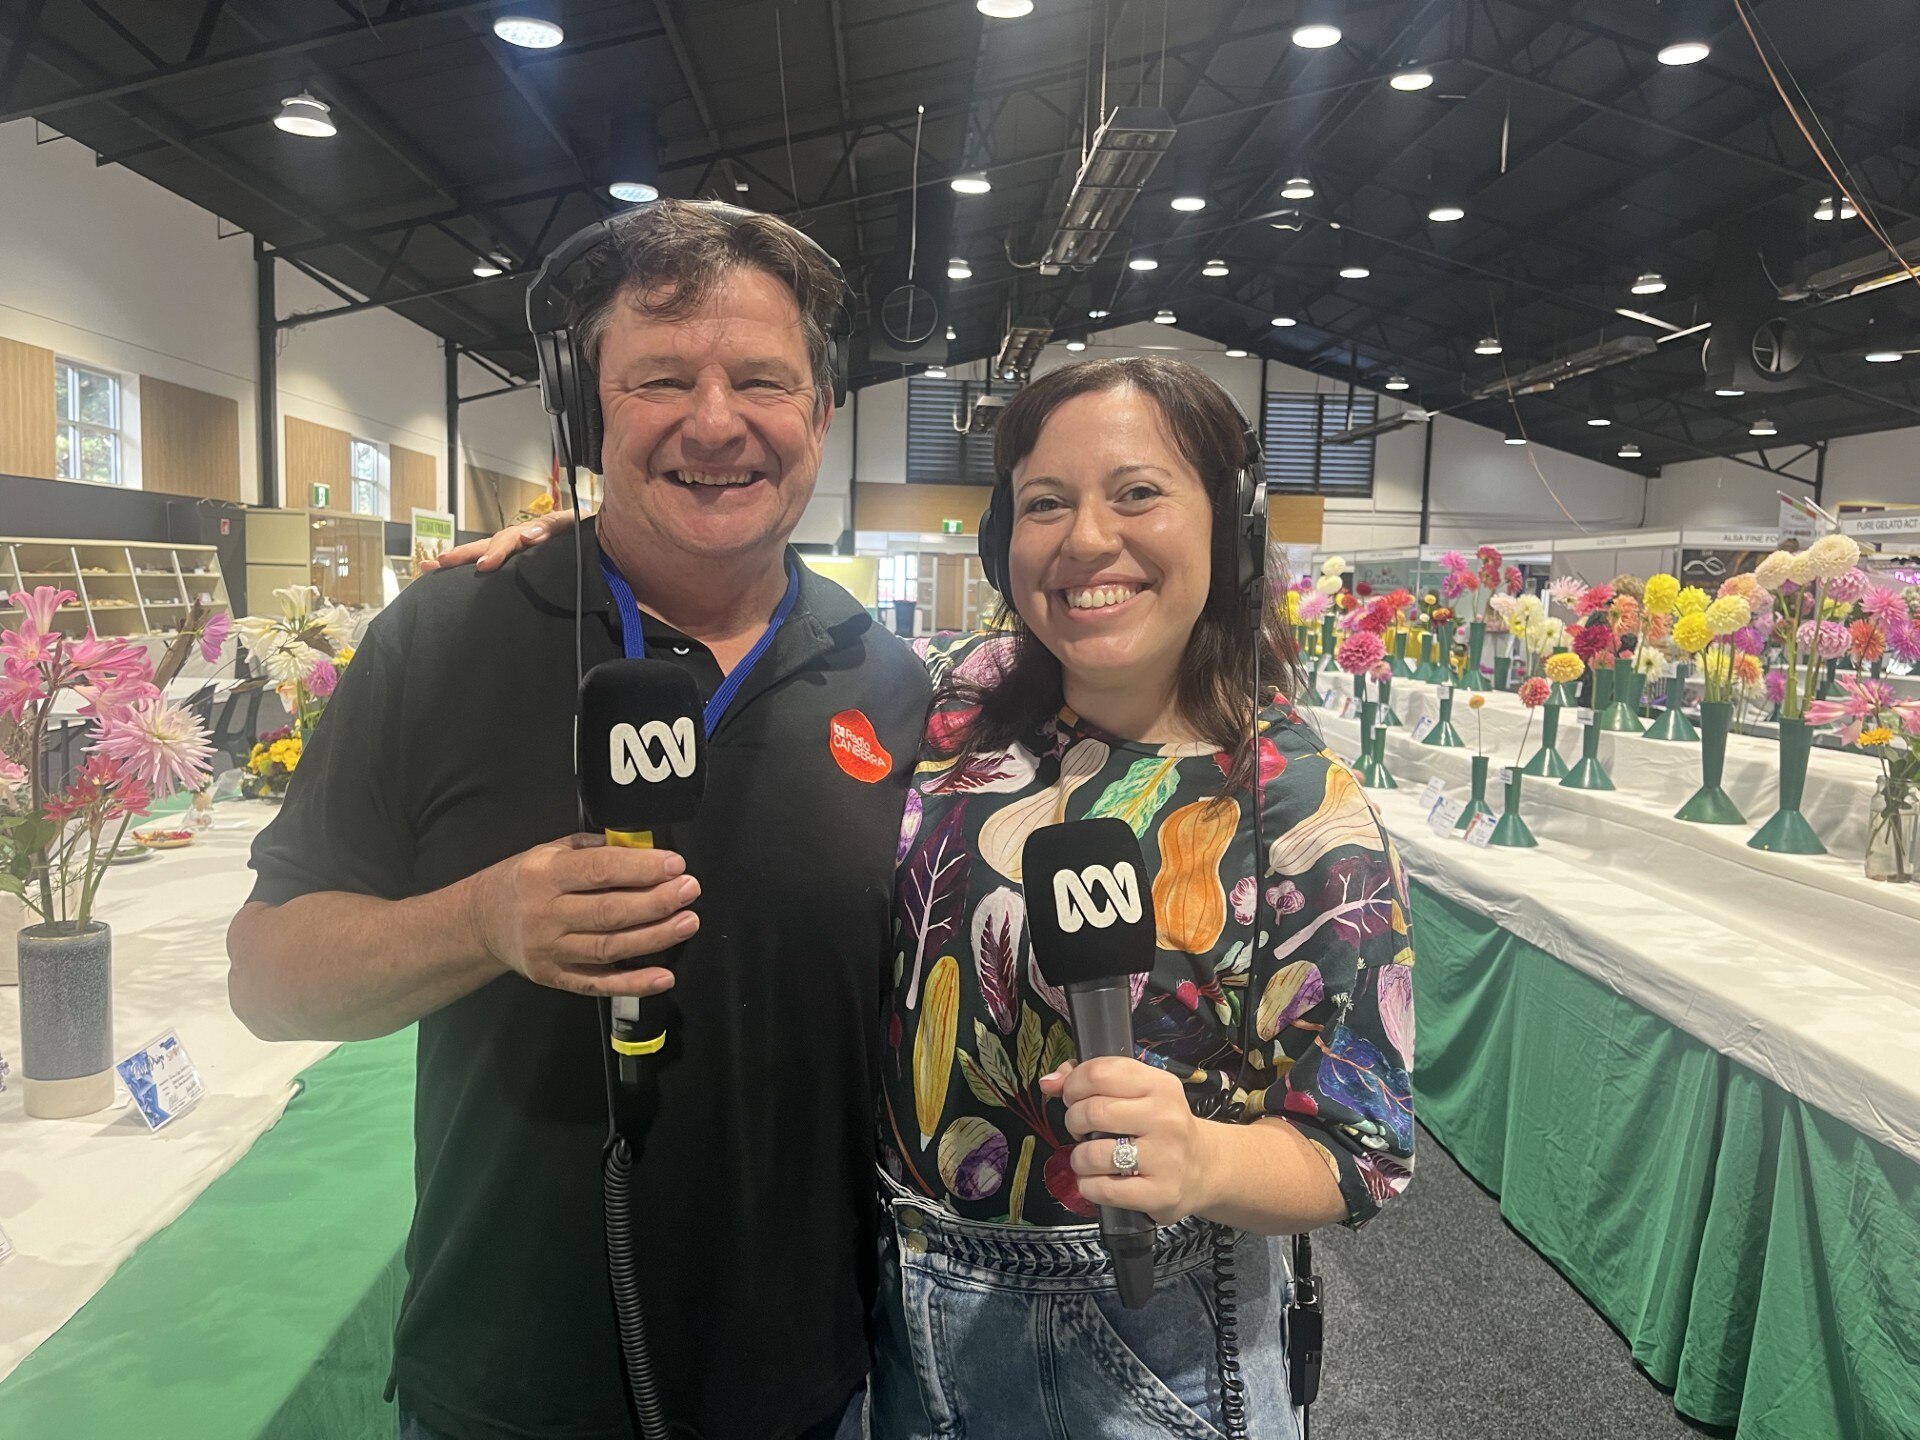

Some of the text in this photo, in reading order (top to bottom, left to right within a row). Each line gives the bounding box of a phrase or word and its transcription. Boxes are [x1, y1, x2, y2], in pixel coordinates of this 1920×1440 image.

[1856, 518, 1918, 531] PURE GELATO ACT
[1745, 534, 1763, 543] FINE
[845, 728, 871, 751] Radio
[833, 734, 887, 768] CANBERRA
